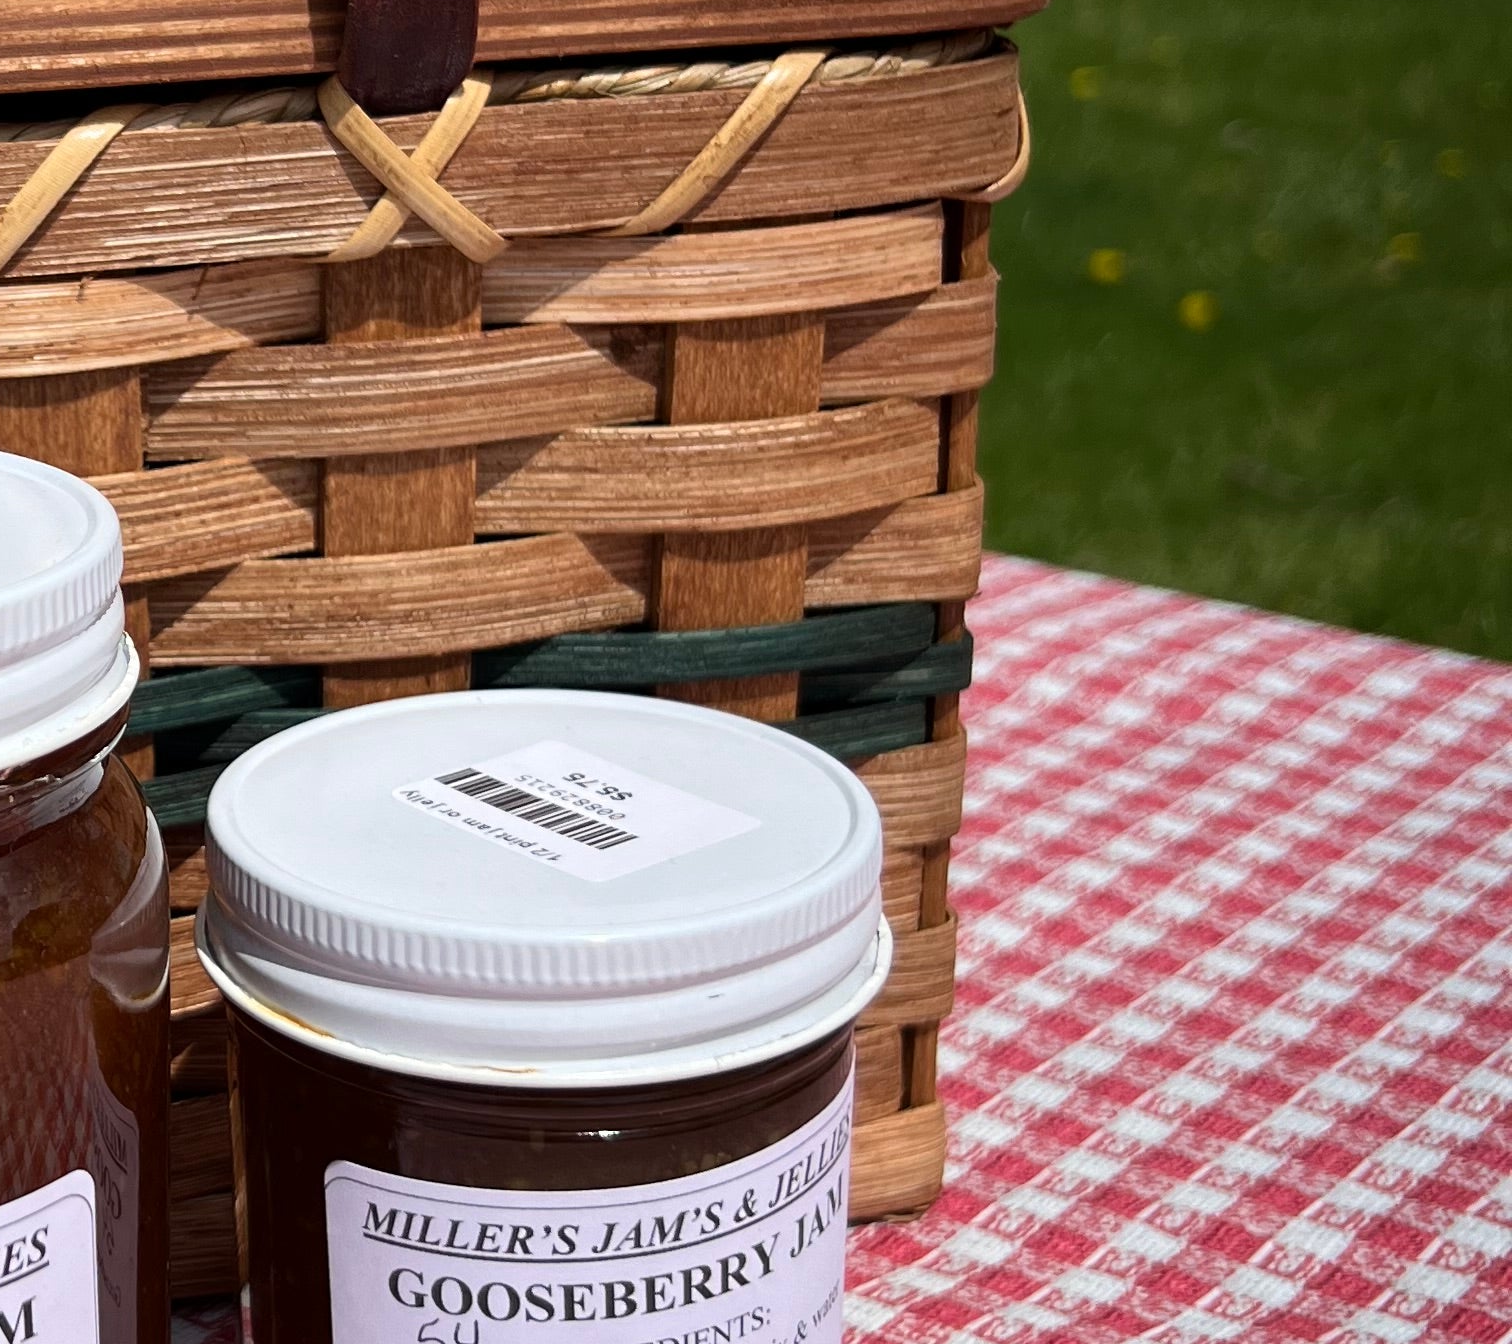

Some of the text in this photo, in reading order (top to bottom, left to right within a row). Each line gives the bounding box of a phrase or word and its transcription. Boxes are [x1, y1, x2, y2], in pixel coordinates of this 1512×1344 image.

[561, 771, 633, 802] $5.75
[399, 789, 563, 862] 1/2 pint jam or jelly
[363, 1201, 579, 1255] MILLER’S
[591, 1202, 725, 1254] JAM’S
[732, 1188, 758, 1219] &
[388, 1170, 843, 1322] GOOSEBERRY JAM
